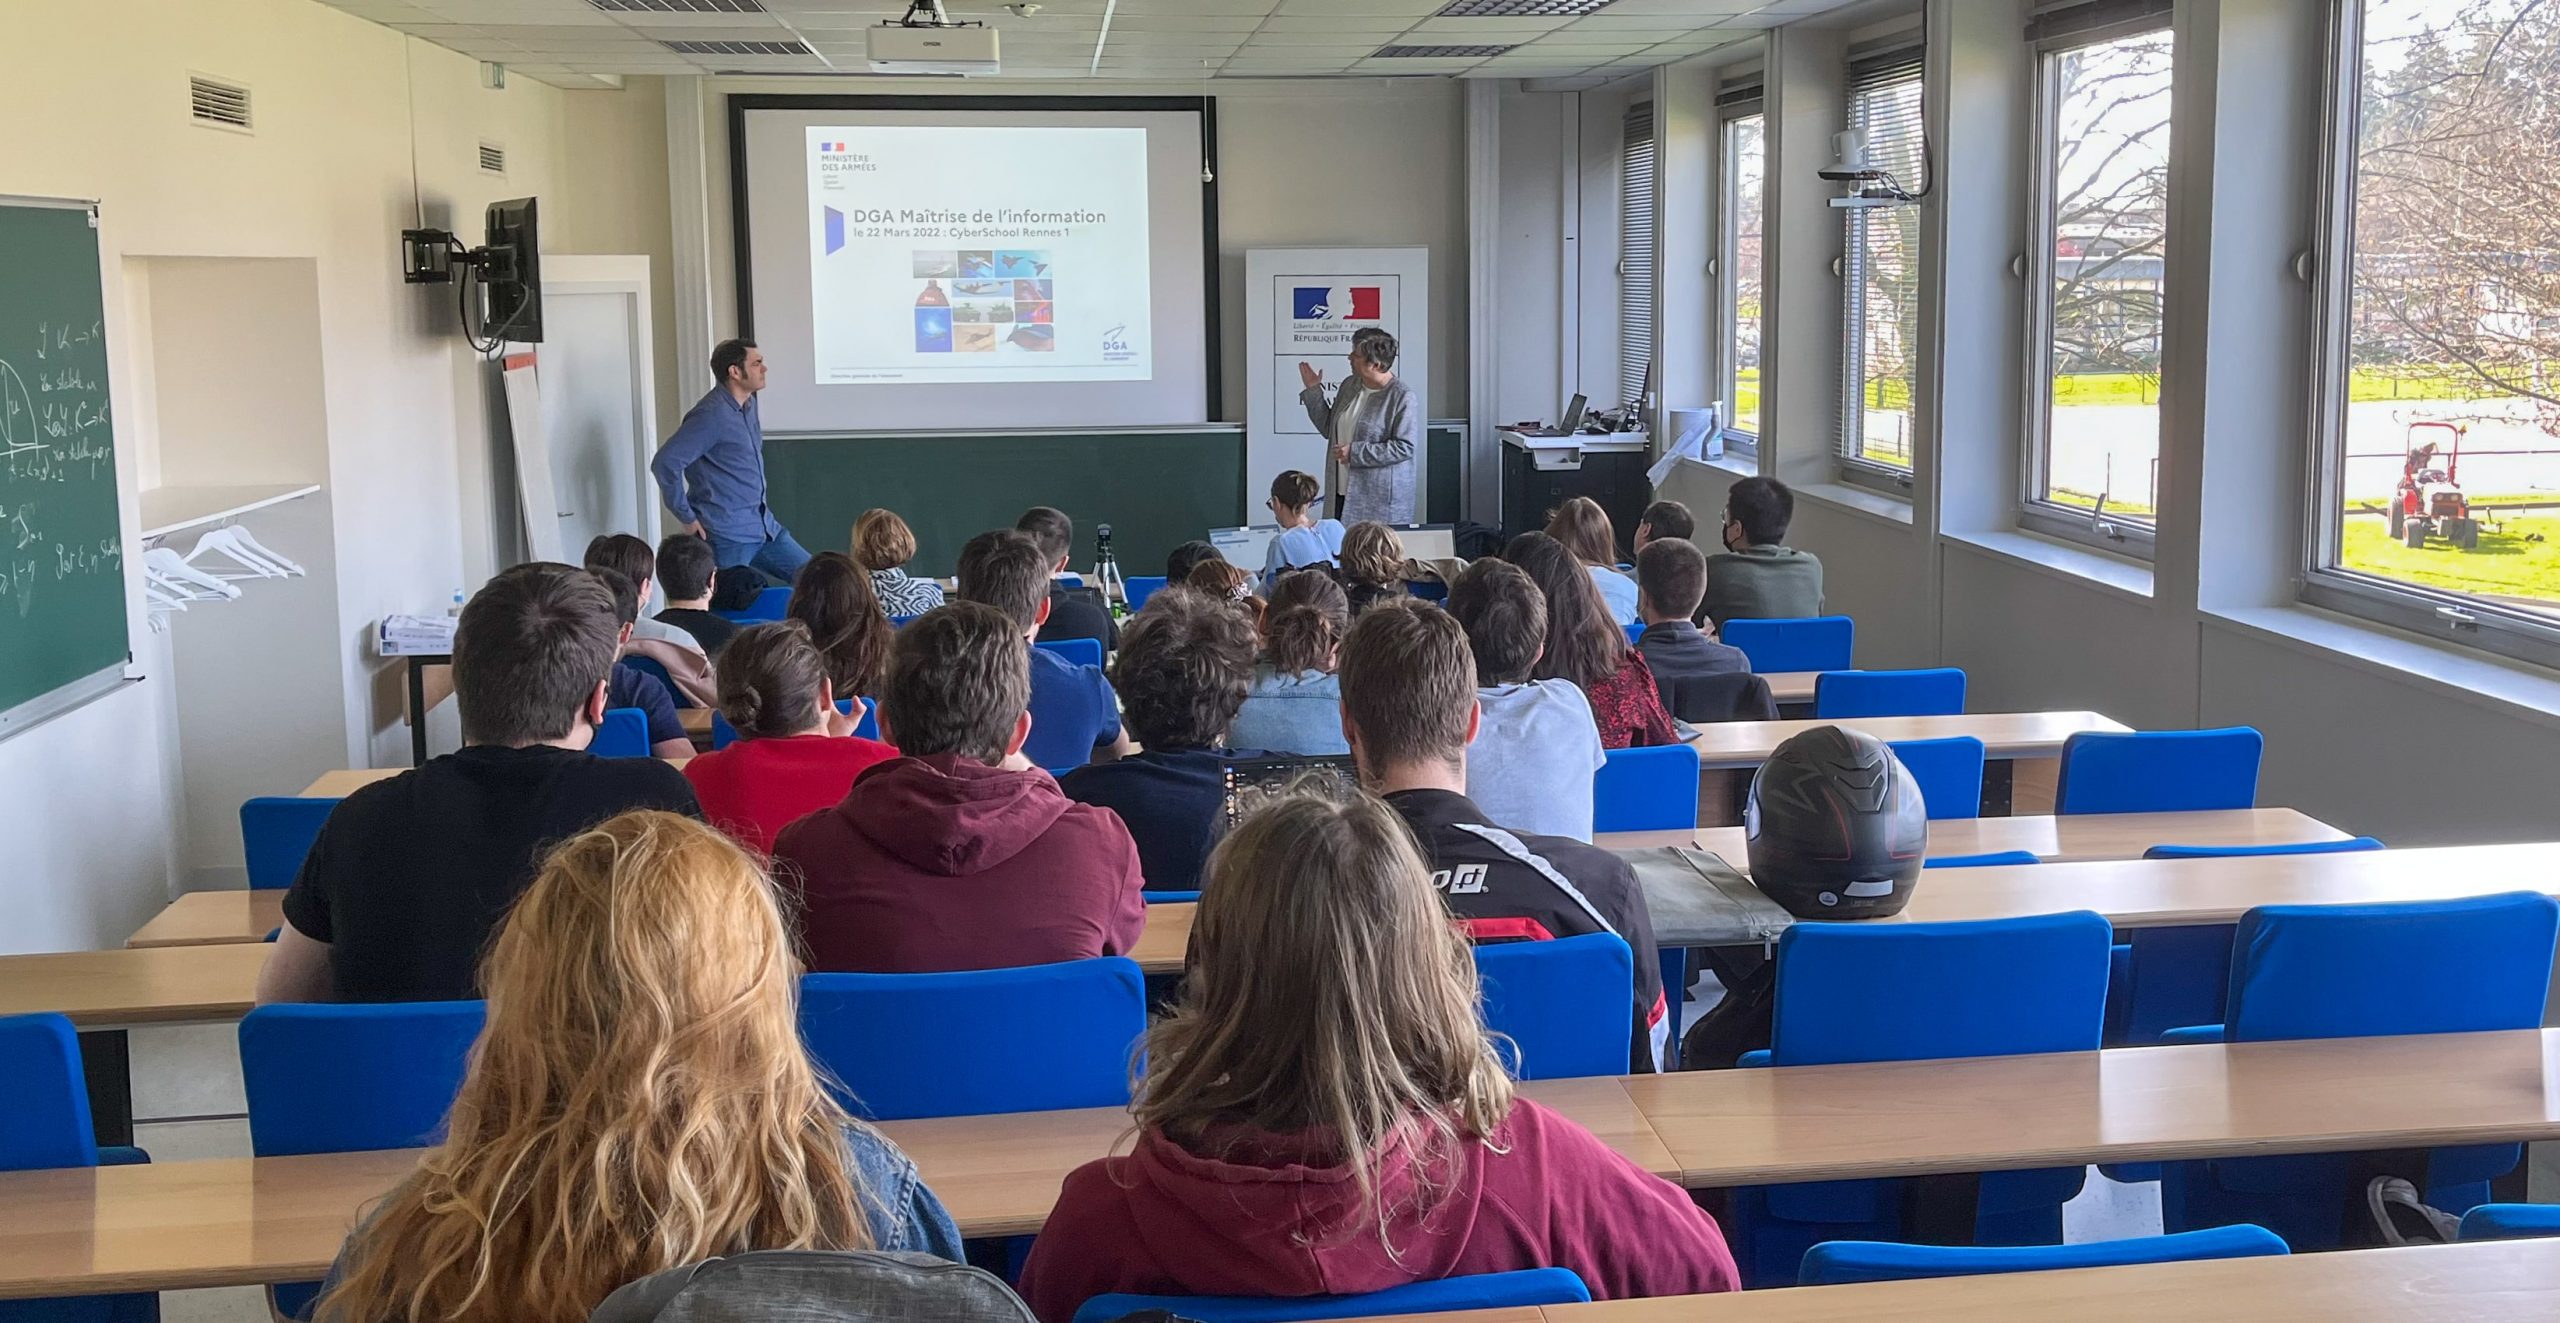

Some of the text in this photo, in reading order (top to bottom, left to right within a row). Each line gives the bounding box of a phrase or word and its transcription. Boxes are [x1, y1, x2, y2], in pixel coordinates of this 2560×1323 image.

[821, 153, 869, 162] MINISTÈRE
[822, 162, 877, 171] DES ARMÉES
[854, 209, 894, 223] DGA
[900, 208, 967, 223] Maîtrise
[972, 209, 993, 223] de
[854, 228, 864, 237] le
[866, 228, 880, 237] 22
[884, 228, 910, 237] Mars
[913, 228, 940, 237] 2022
[949, 227, 1020, 240] CyberSchool
[1023, 228, 1062, 237] Rennes
[1293, 334, 1339, 344] RÉPUBLIQUE
[1103, 341, 1128, 350] DGA
